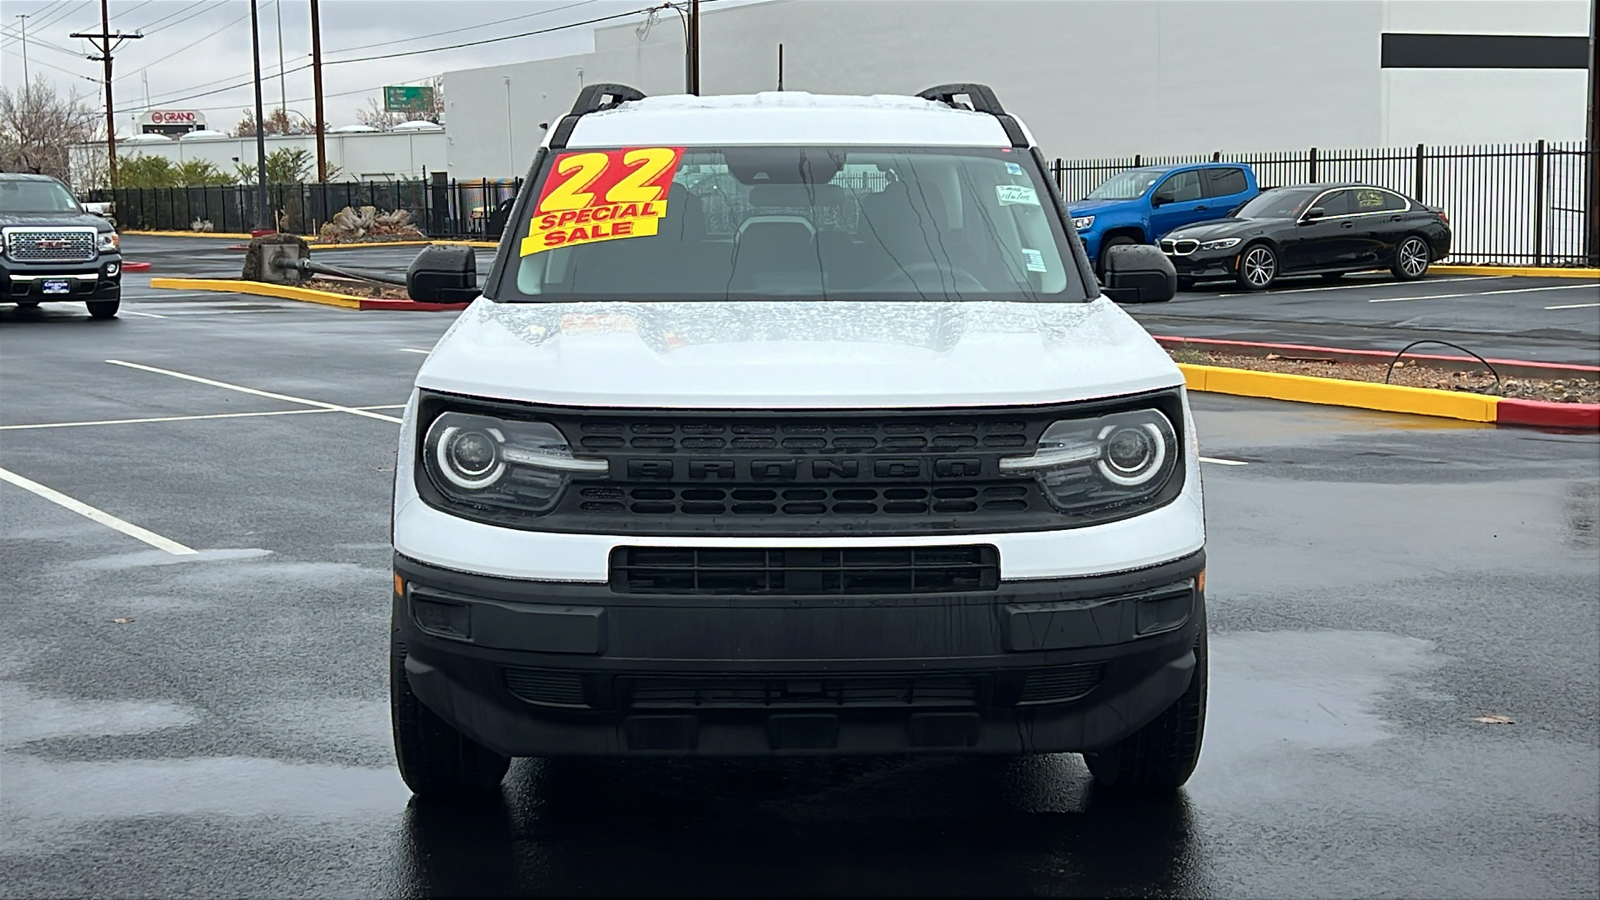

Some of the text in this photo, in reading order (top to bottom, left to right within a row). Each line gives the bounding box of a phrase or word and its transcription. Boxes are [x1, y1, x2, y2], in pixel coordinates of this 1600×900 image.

[163, 112, 195, 121] GRAND
[539, 147, 676, 213] 22
[539, 202, 658, 230] SPECIAL
[543, 221, 634, 247] SALE
[627, 458, 981, 478] BRONCO
